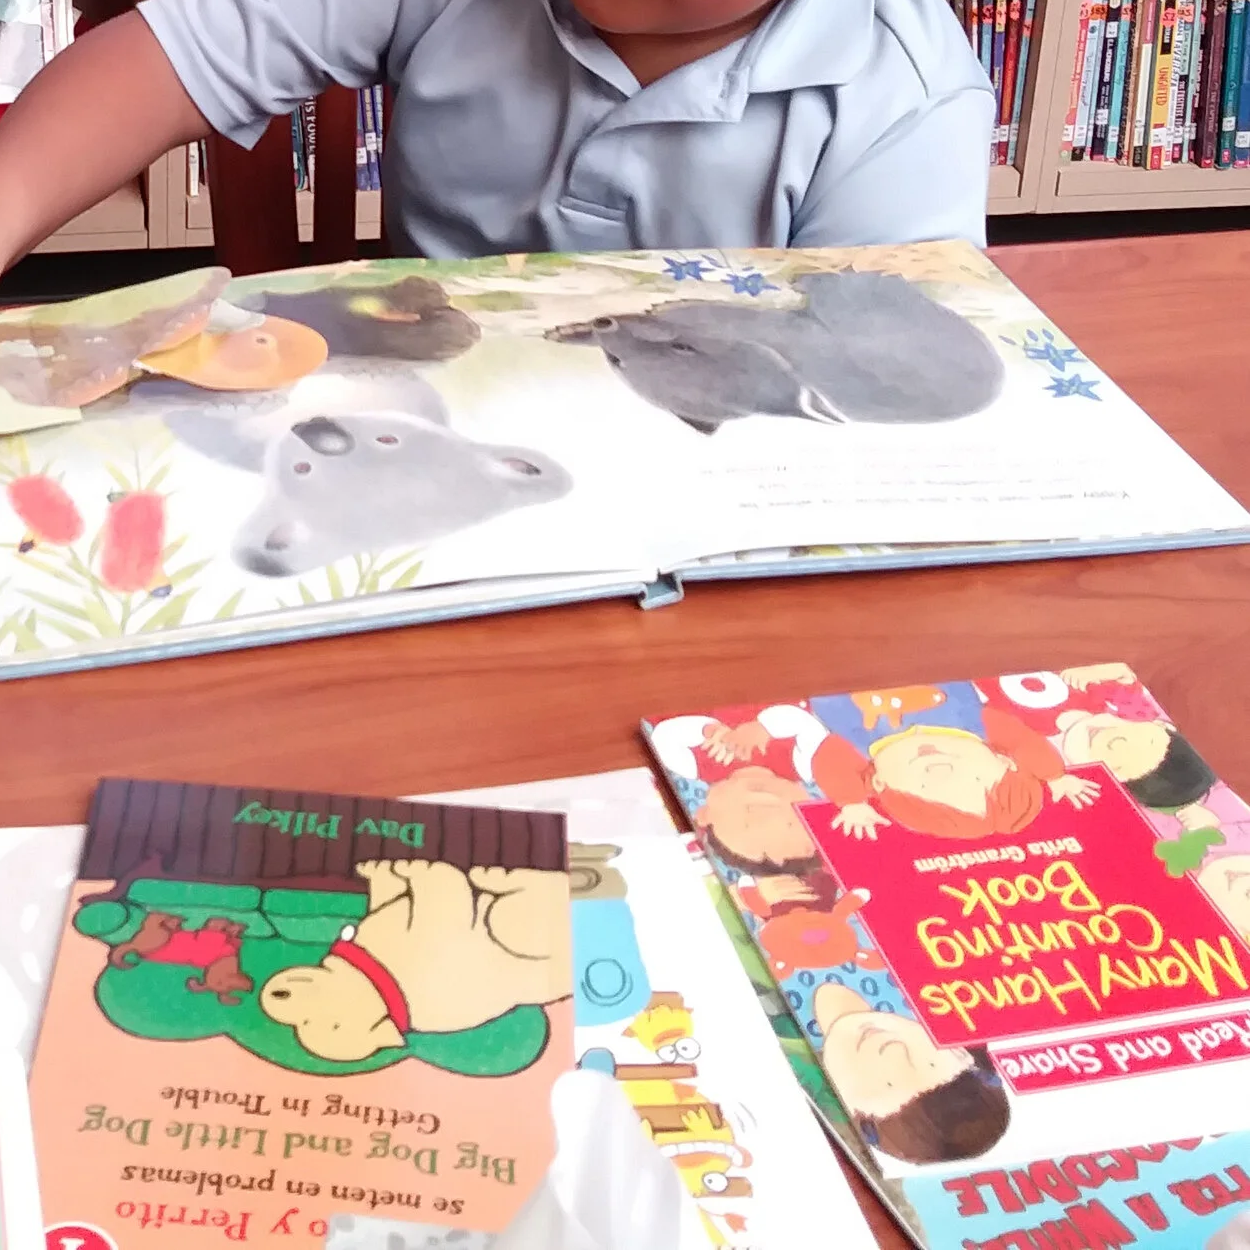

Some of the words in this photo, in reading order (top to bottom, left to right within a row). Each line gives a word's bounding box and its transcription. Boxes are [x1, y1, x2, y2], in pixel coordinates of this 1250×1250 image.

[1155, 66, 1169, 106] UNGIFTED
[233, 801, 341, 840] Pilkey
[356, 816, 425, 848] Dav
[913, 846, 1026, 873] Granström
[1027, 836, 1083, 857] Brita
[939, 859, 1104, 925] Book
[916, 904, 1164, 970] Counting
[1100, 935, 1248, 998] Many
[921, 959, 1102, 1031] Hands
[1005, 1037, 1103, 1080] Share
[1108, 1035, 1172, 1073] and
[1178, 1019, 1250, 1062] Read
[160, 1086, 273, 1117] Trouble
[282, 1094, 313, 1115] in
[323, 1094, 441, 1135] Getting
[78, 1104, 151, 1148] Dog
[165, 1120, 268, 1157] Little
[284, 1131, 352, 1160] and
[366, 1131, 439, 1176] Dog
[453, 1141, 517, 1185] Big
[120, 1164, 275, 1195] problemas
[285, 1179, 320, 1197] en
[330, 1184, 421, 1211] meten
[115, 1202, 252, 1242] Perrito
[270, 1207, 301, 1238] y
[433, 1197, 465, 1216] se
